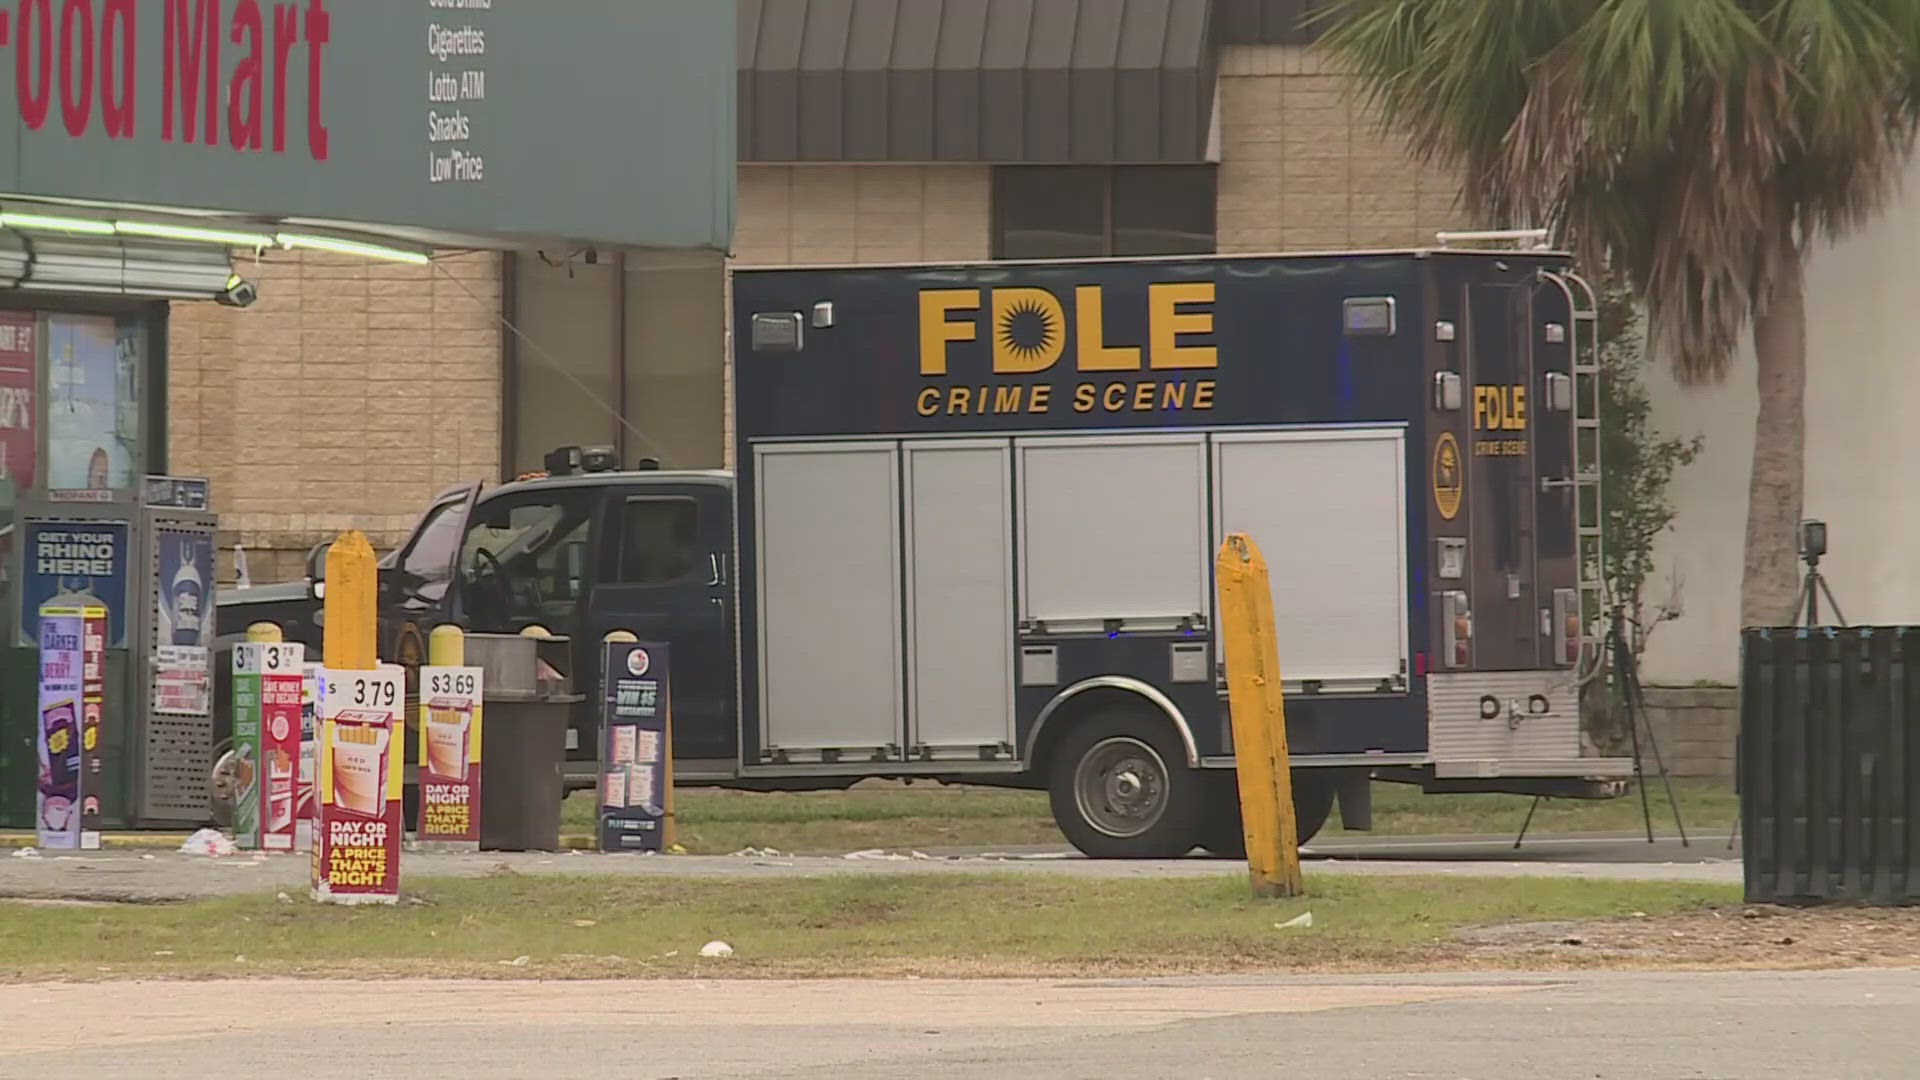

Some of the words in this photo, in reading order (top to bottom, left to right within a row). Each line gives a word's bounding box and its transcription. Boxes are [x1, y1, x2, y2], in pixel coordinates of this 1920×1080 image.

[429, 24, 484, 62] Cigarettes
[0, 0, 135, 139] ood
[161, 0, 329, 160] Mart
[429, 71, 457, 101] Lotto
[461, 71, 484, 99] ATM
[429, 110, 469, 142] Snacks
[430, 151, 452, 182] Low
[454, 149, 483, 181] Price
[918, 282, 1219, 375] FDLE
[916, 385, 1053, 416] CRIME
[1072, 380, 1218, 412] SCENE
[1473, 385, 1527, 431] FDLE
[37, 532, 68, 543] GET
[72, 533, 113, 544] YOUR
[37, 543, 113, 559] RHINO
[37, 558, 112, 576] HERE!
[44, 634, 78, 650] DARKER
[426, 784, 450, 794] DAY
[452, 785, 470, 794] OR
[425, 793, 470, 804] NIGHT
[427, 805, 435, 814] A
[437, 805, 469, 814] PRICE
[425, 814, 469, 824] THAT'S
[330, 821, 362, 833] DAY
[364, 822, 387, 833] OR
[425, 823, 470, 835] RIGHT
[329, 832, 388, 847] NIGHT
[331, 848, 341, 858] A
[344, 848, 387, 859] PRICE
[329, 859, 387, 871] THAT'S
[328, 871, 387, 885] RIGHT
